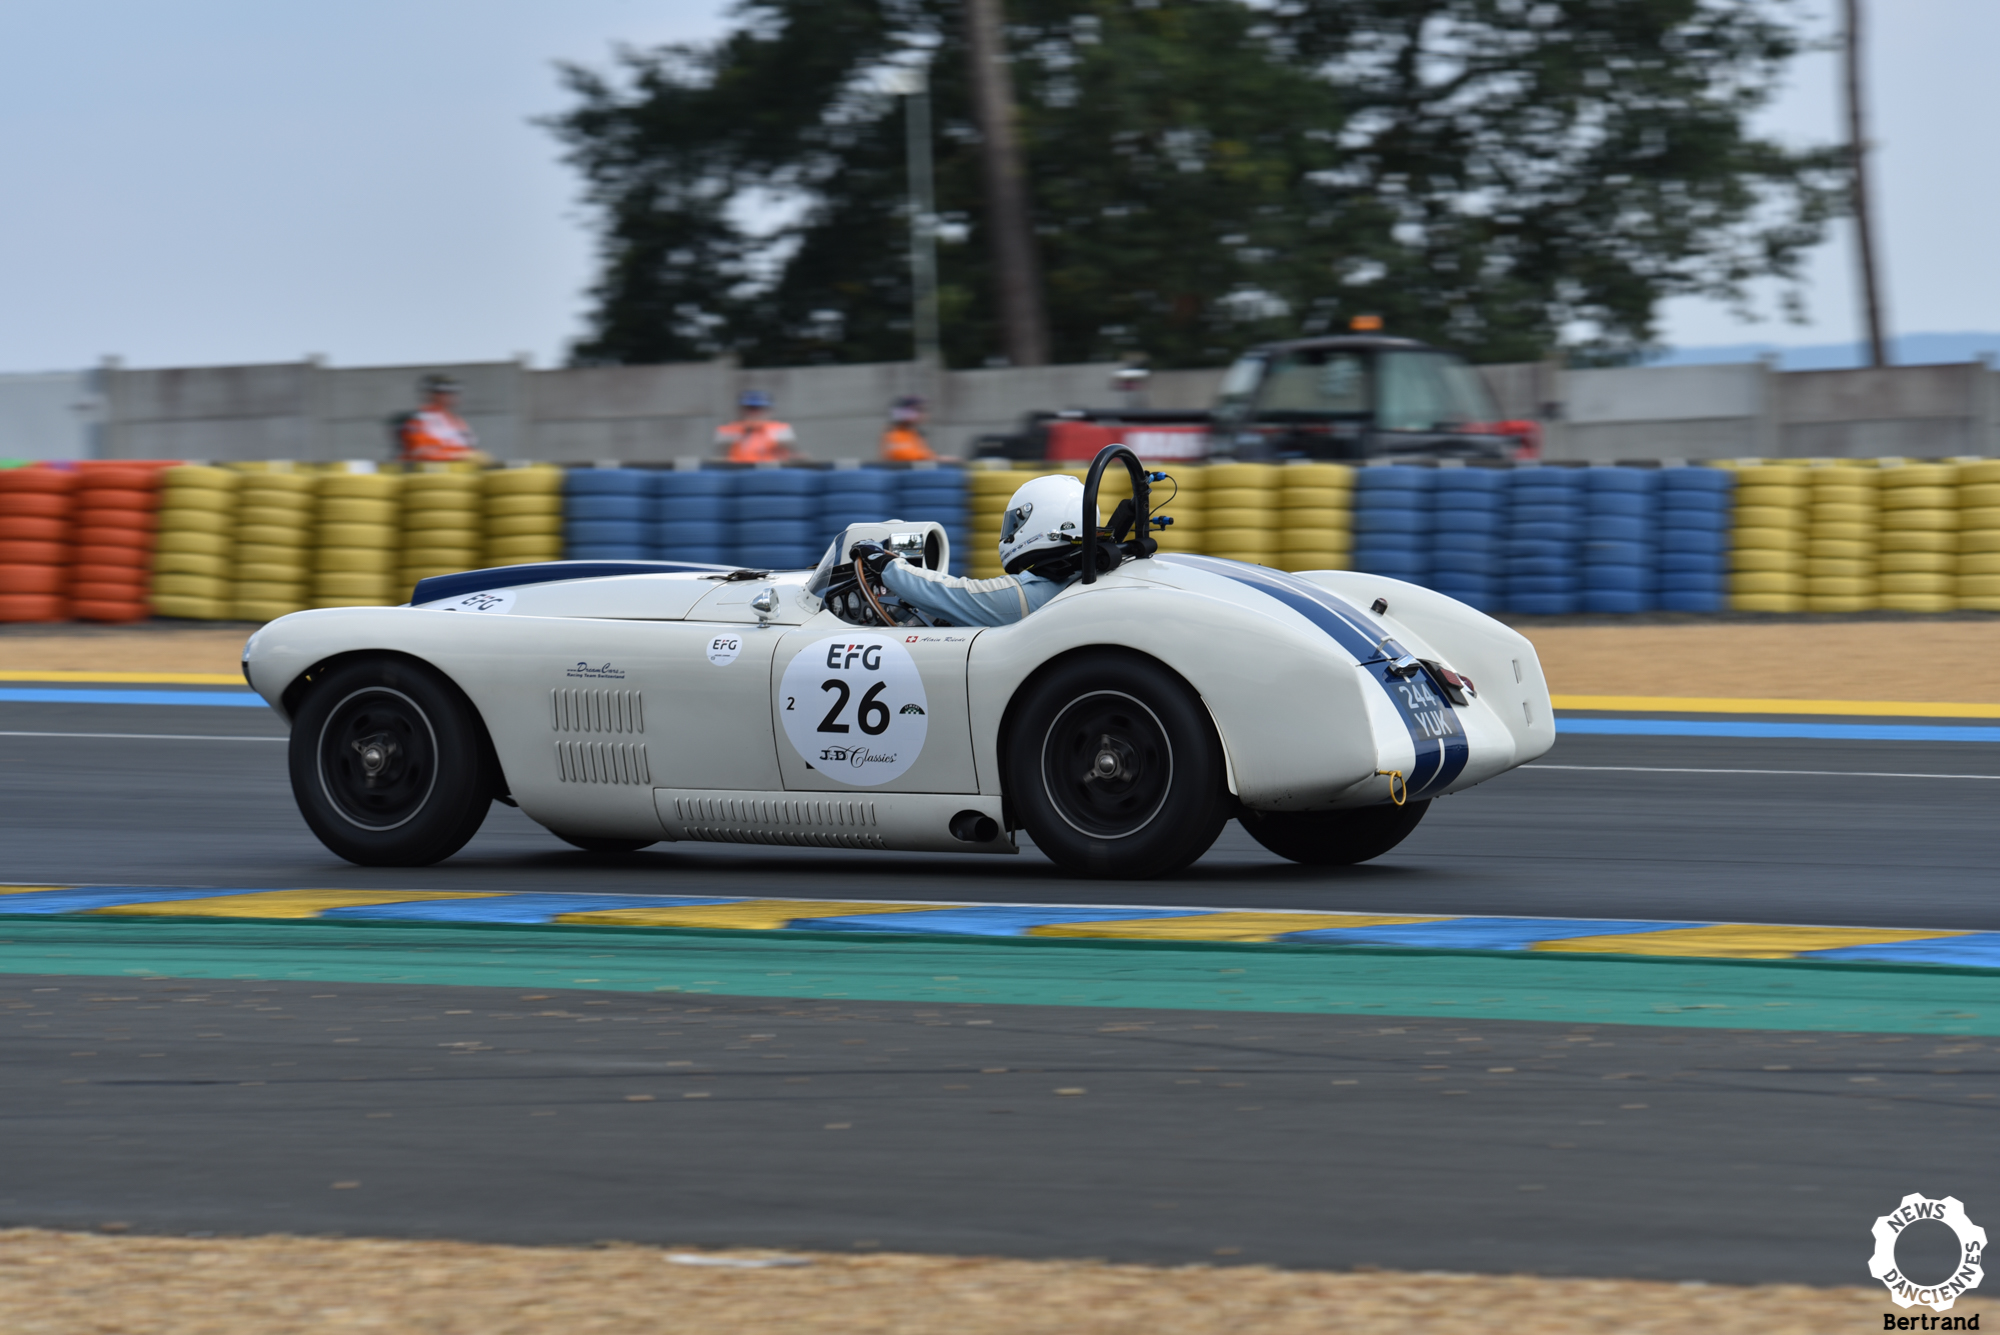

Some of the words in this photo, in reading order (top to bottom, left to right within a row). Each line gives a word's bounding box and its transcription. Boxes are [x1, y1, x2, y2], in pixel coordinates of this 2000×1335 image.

[712, 639, 738, 650] EFG
[826, 643, 883, 671] EFG
[786, 696, 795, 711] 2
[816, 678, 891, 736] 26
[1398, 683, 1437, 710] 244
[1413, 709, 1453, 738] YUK
